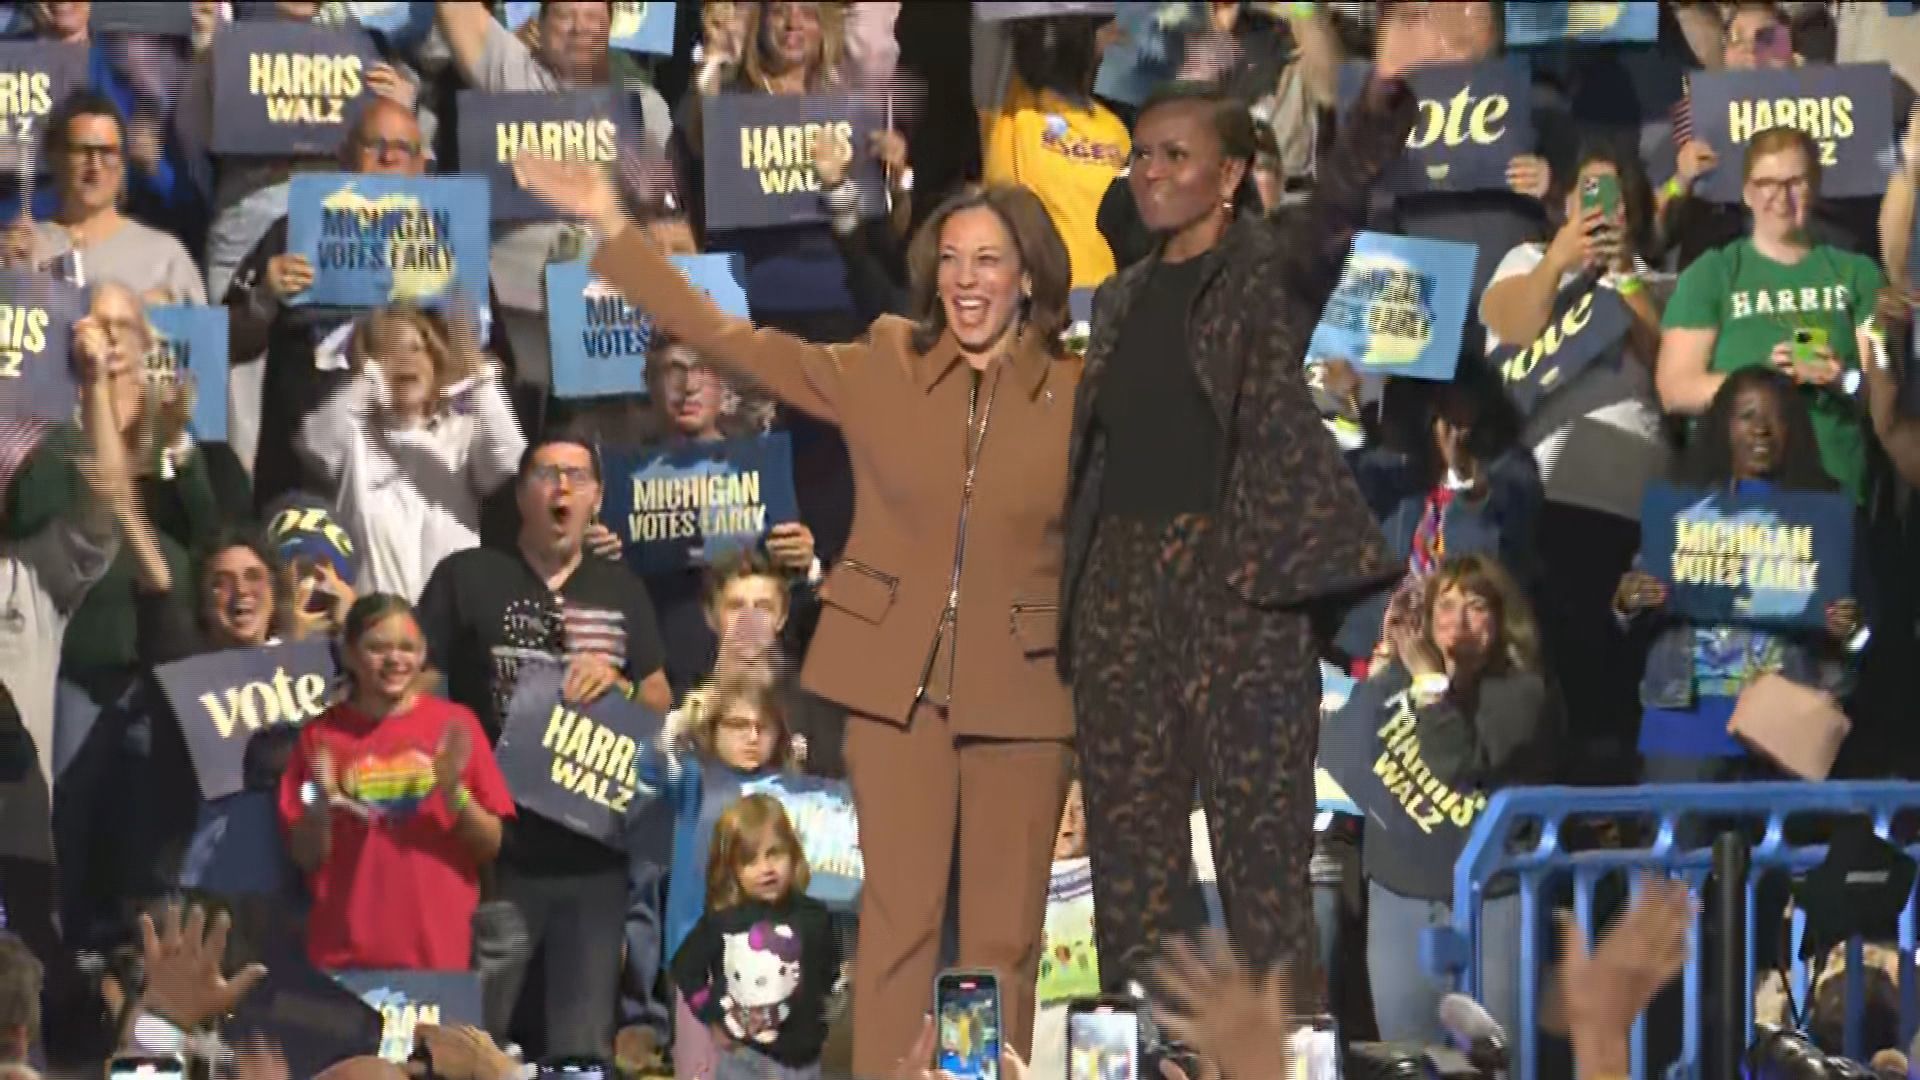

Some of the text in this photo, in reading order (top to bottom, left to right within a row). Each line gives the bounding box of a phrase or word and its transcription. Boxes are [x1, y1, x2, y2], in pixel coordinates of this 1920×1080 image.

[249, 53, 362, 97] HARRIS
[267, 98, 343, 123] WALZ
[1405, 84, 1509, 149] ote
[1729, 96, 1854, 143] HARRIS
[496, 118, 618, 162] HARRIS
[741, 121, 853, 169] HARRS
[760, 169, 821, 194] WAL
[322, 207, 450, 239] MICHIGAN
[318, 241, 387, 271] VOTES
[633, 471, 760, 511] MICHIGAN
[267, 508, 354, 557] ote
[628, 503, 766, 542] VOTES EARLY
[1675, 518, 1813, 562] MICHIGAN
[1671, 551, 1742, 588] VOTES
[198, 666, 328, 739] vote
[542, 703, 637, 786] HARR
[551, 756, 635, 813] WALZ
[1373, 751, 1444, 834] WALZ
